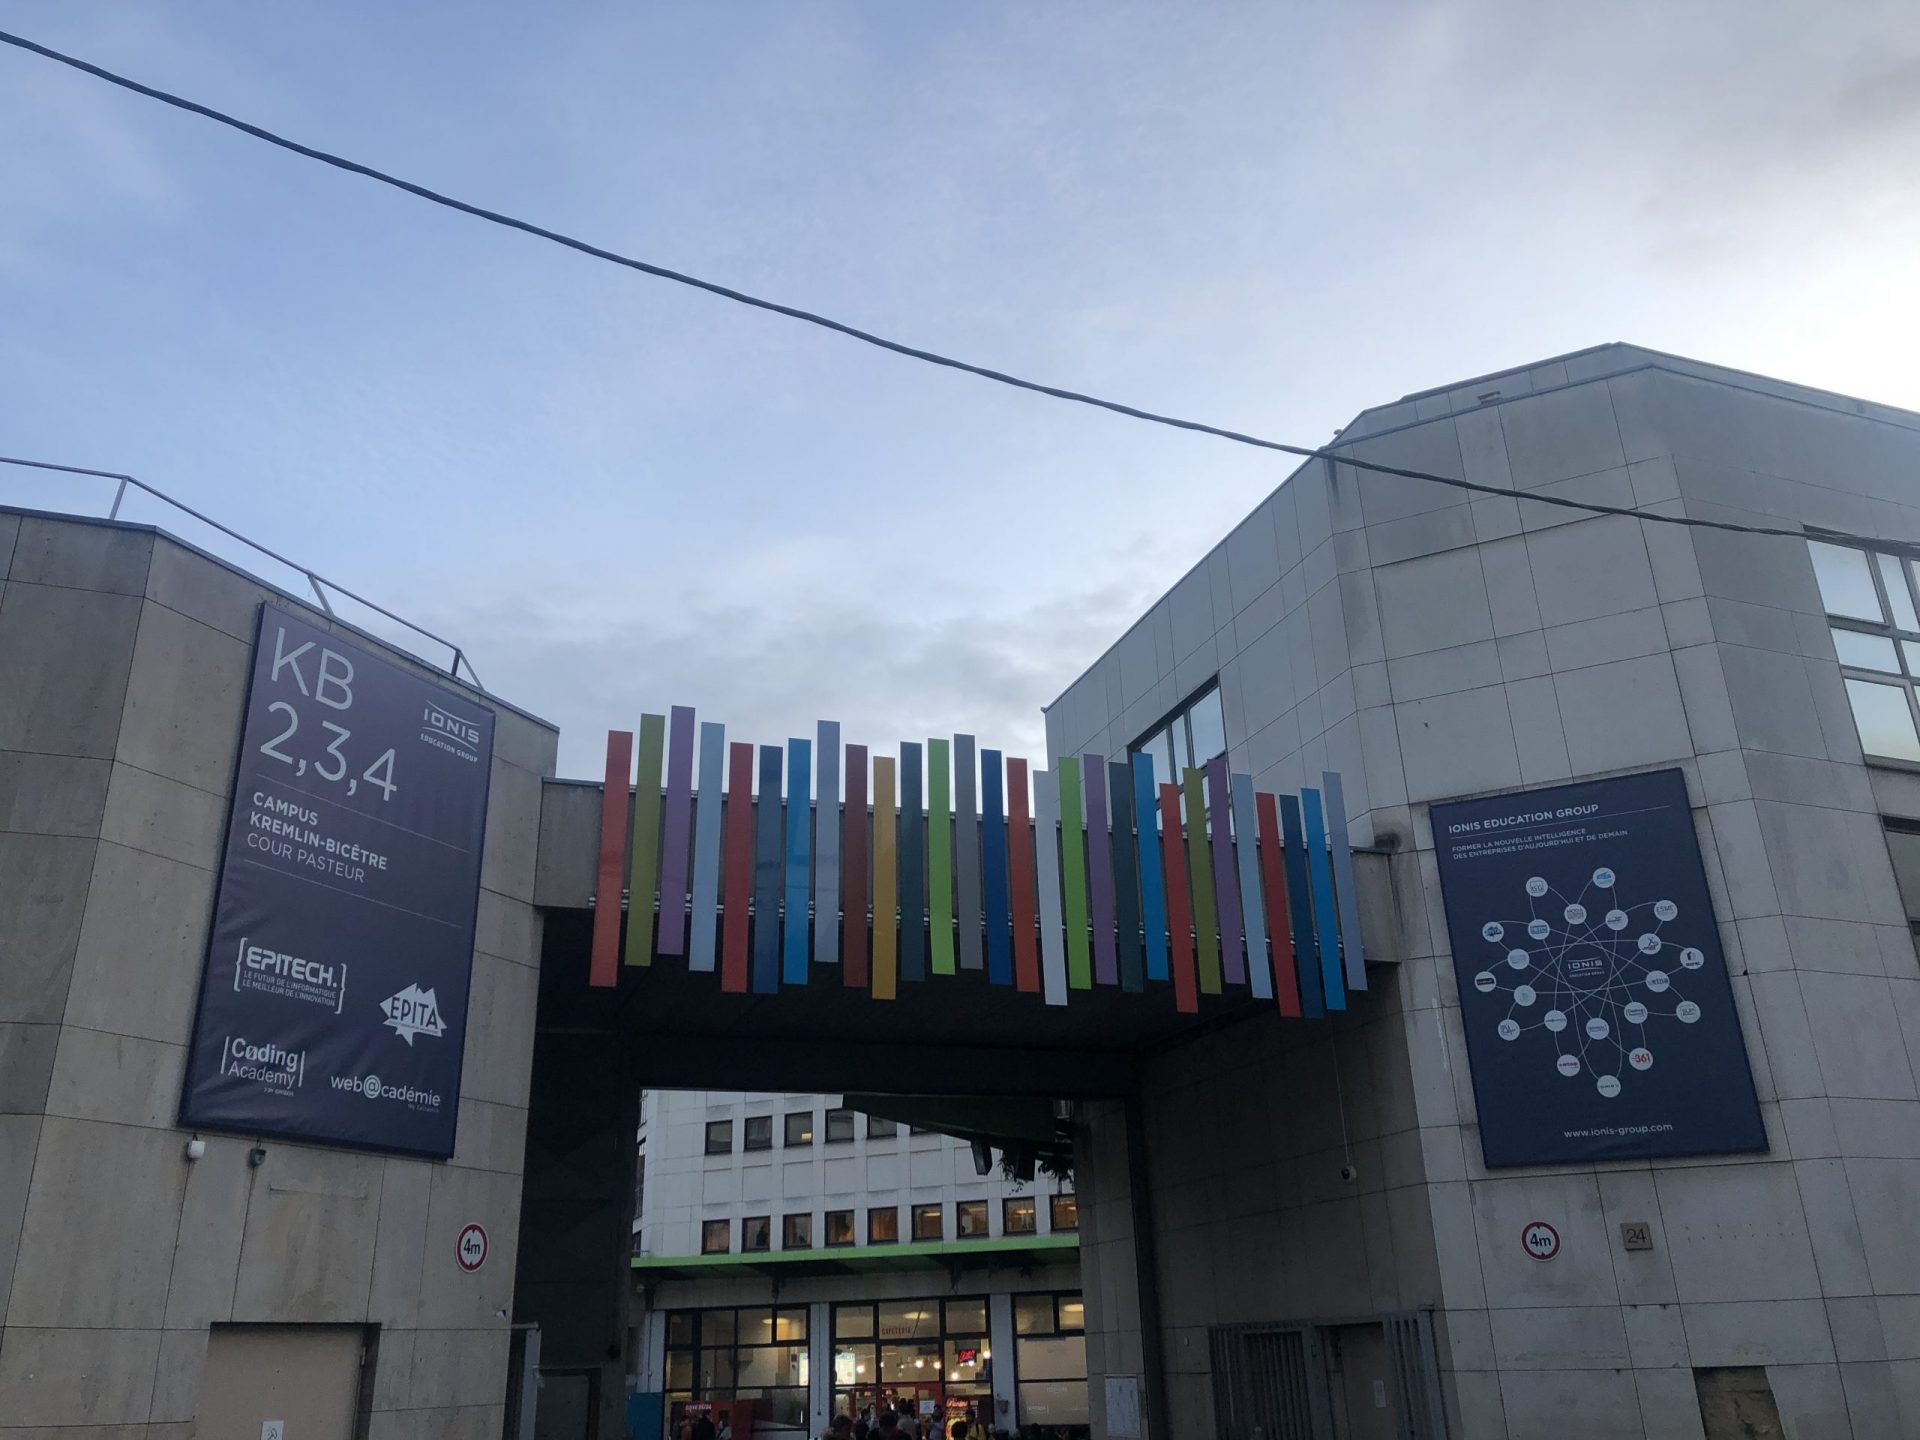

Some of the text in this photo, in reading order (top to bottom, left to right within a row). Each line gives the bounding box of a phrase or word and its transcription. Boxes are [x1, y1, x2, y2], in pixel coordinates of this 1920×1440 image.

[271, 626, 354, 711] KB
[424, 708, 479, 744] IONIS
[420, 733, 478, 762] EDUCATION GROUP
[253, 791, 318, 826] CAMPUS
[1448, 804, 1599, 834] IONIS EDUCATION GROUP
[250, 811, 388, 871] KREMLIN-BICÊTRE
[1452, 843, 1481, 852] FORMER
[1494, 835, 1532, 846] NOUVELLE
[1534, 828, 1586, 841] INTELLIGENCE
[1453, 852, 1467, 860] DES
[1469, 846, 1516, 858] ENTREPRISES
[1598, 830, 1628, 839] DEMAIN
[247, 832, 365, 884] COUR PASTEUR
[242, 979, 250, 987] LE
[252, 981, 284, 995] MEILLEUR
[285, 988, 294, 997] DE
[244, 970, 251, 979] LE
[253, 972, 275, 984] FUTUR
[276, 978, 286, 987] DE
[390, 997, 438, 1030] EPITA
[228, 1061, 295, 1090] Academy
[1564, 1122, 1673, 1138] www.ionis-group.com
[463, 1238, 480, 1255] 4m
[1530, 1233, 1551, 1247] 4m
[1626, 1228, 1647, 1244] 24
